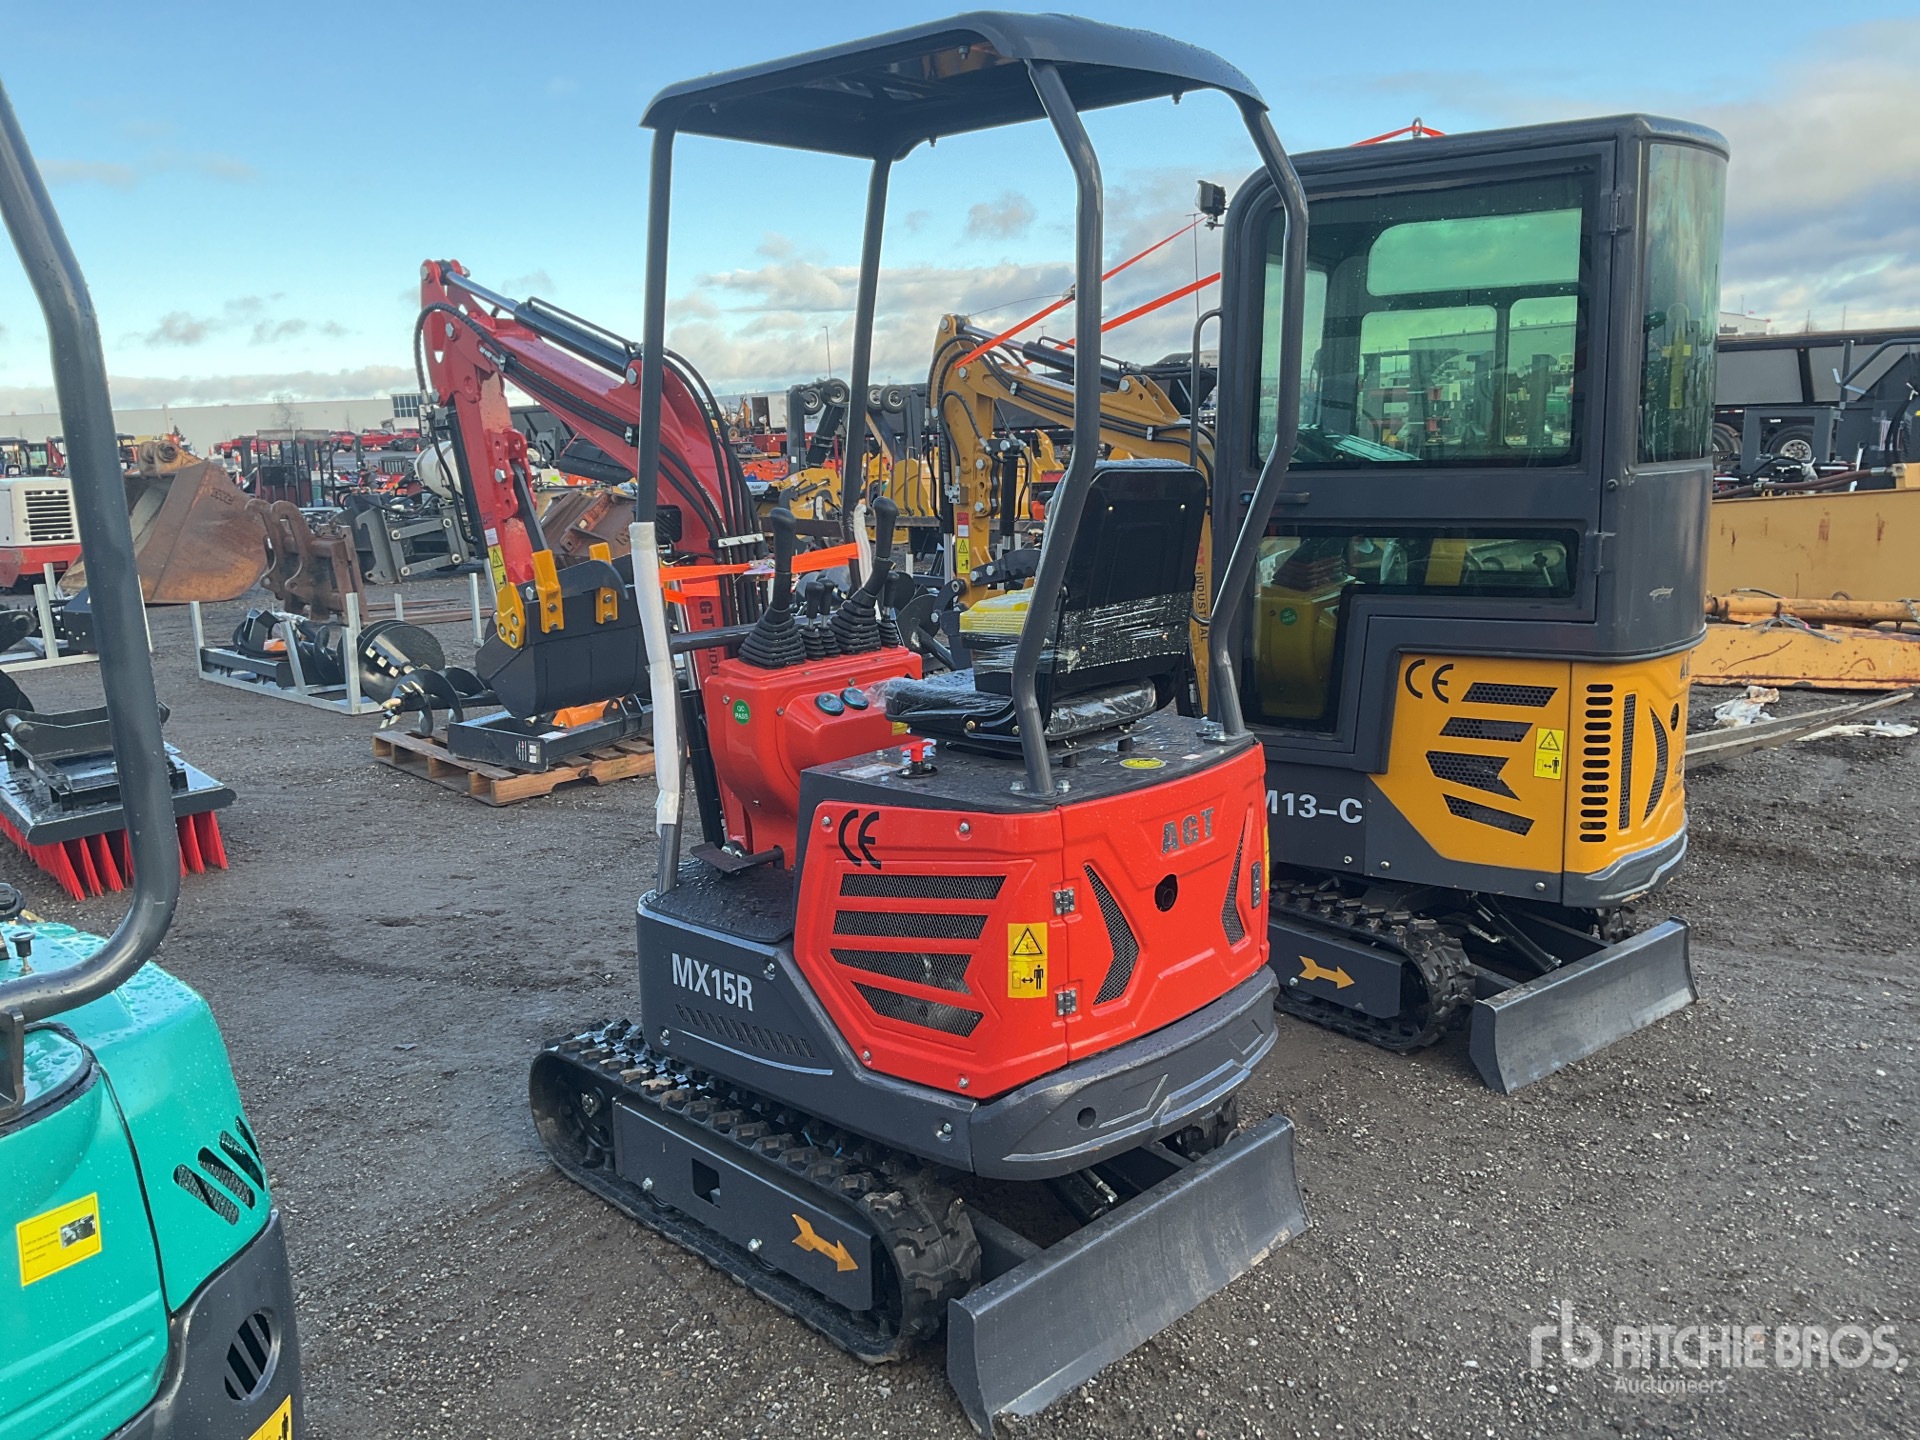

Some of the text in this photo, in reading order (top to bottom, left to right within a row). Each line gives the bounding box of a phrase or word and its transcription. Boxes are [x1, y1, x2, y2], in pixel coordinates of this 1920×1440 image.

[699, 598, 716, 628] GT
[1194, 571, 1208, 642] INDUSTIAL
[1405, 659, 1454, 704] CE
[735, 712, 749, 720] PASS
[838, 809, 881, 870] CE
[1161, 806, 1214, 854] AGT
[672, 953, 753, 1012] MX15R
